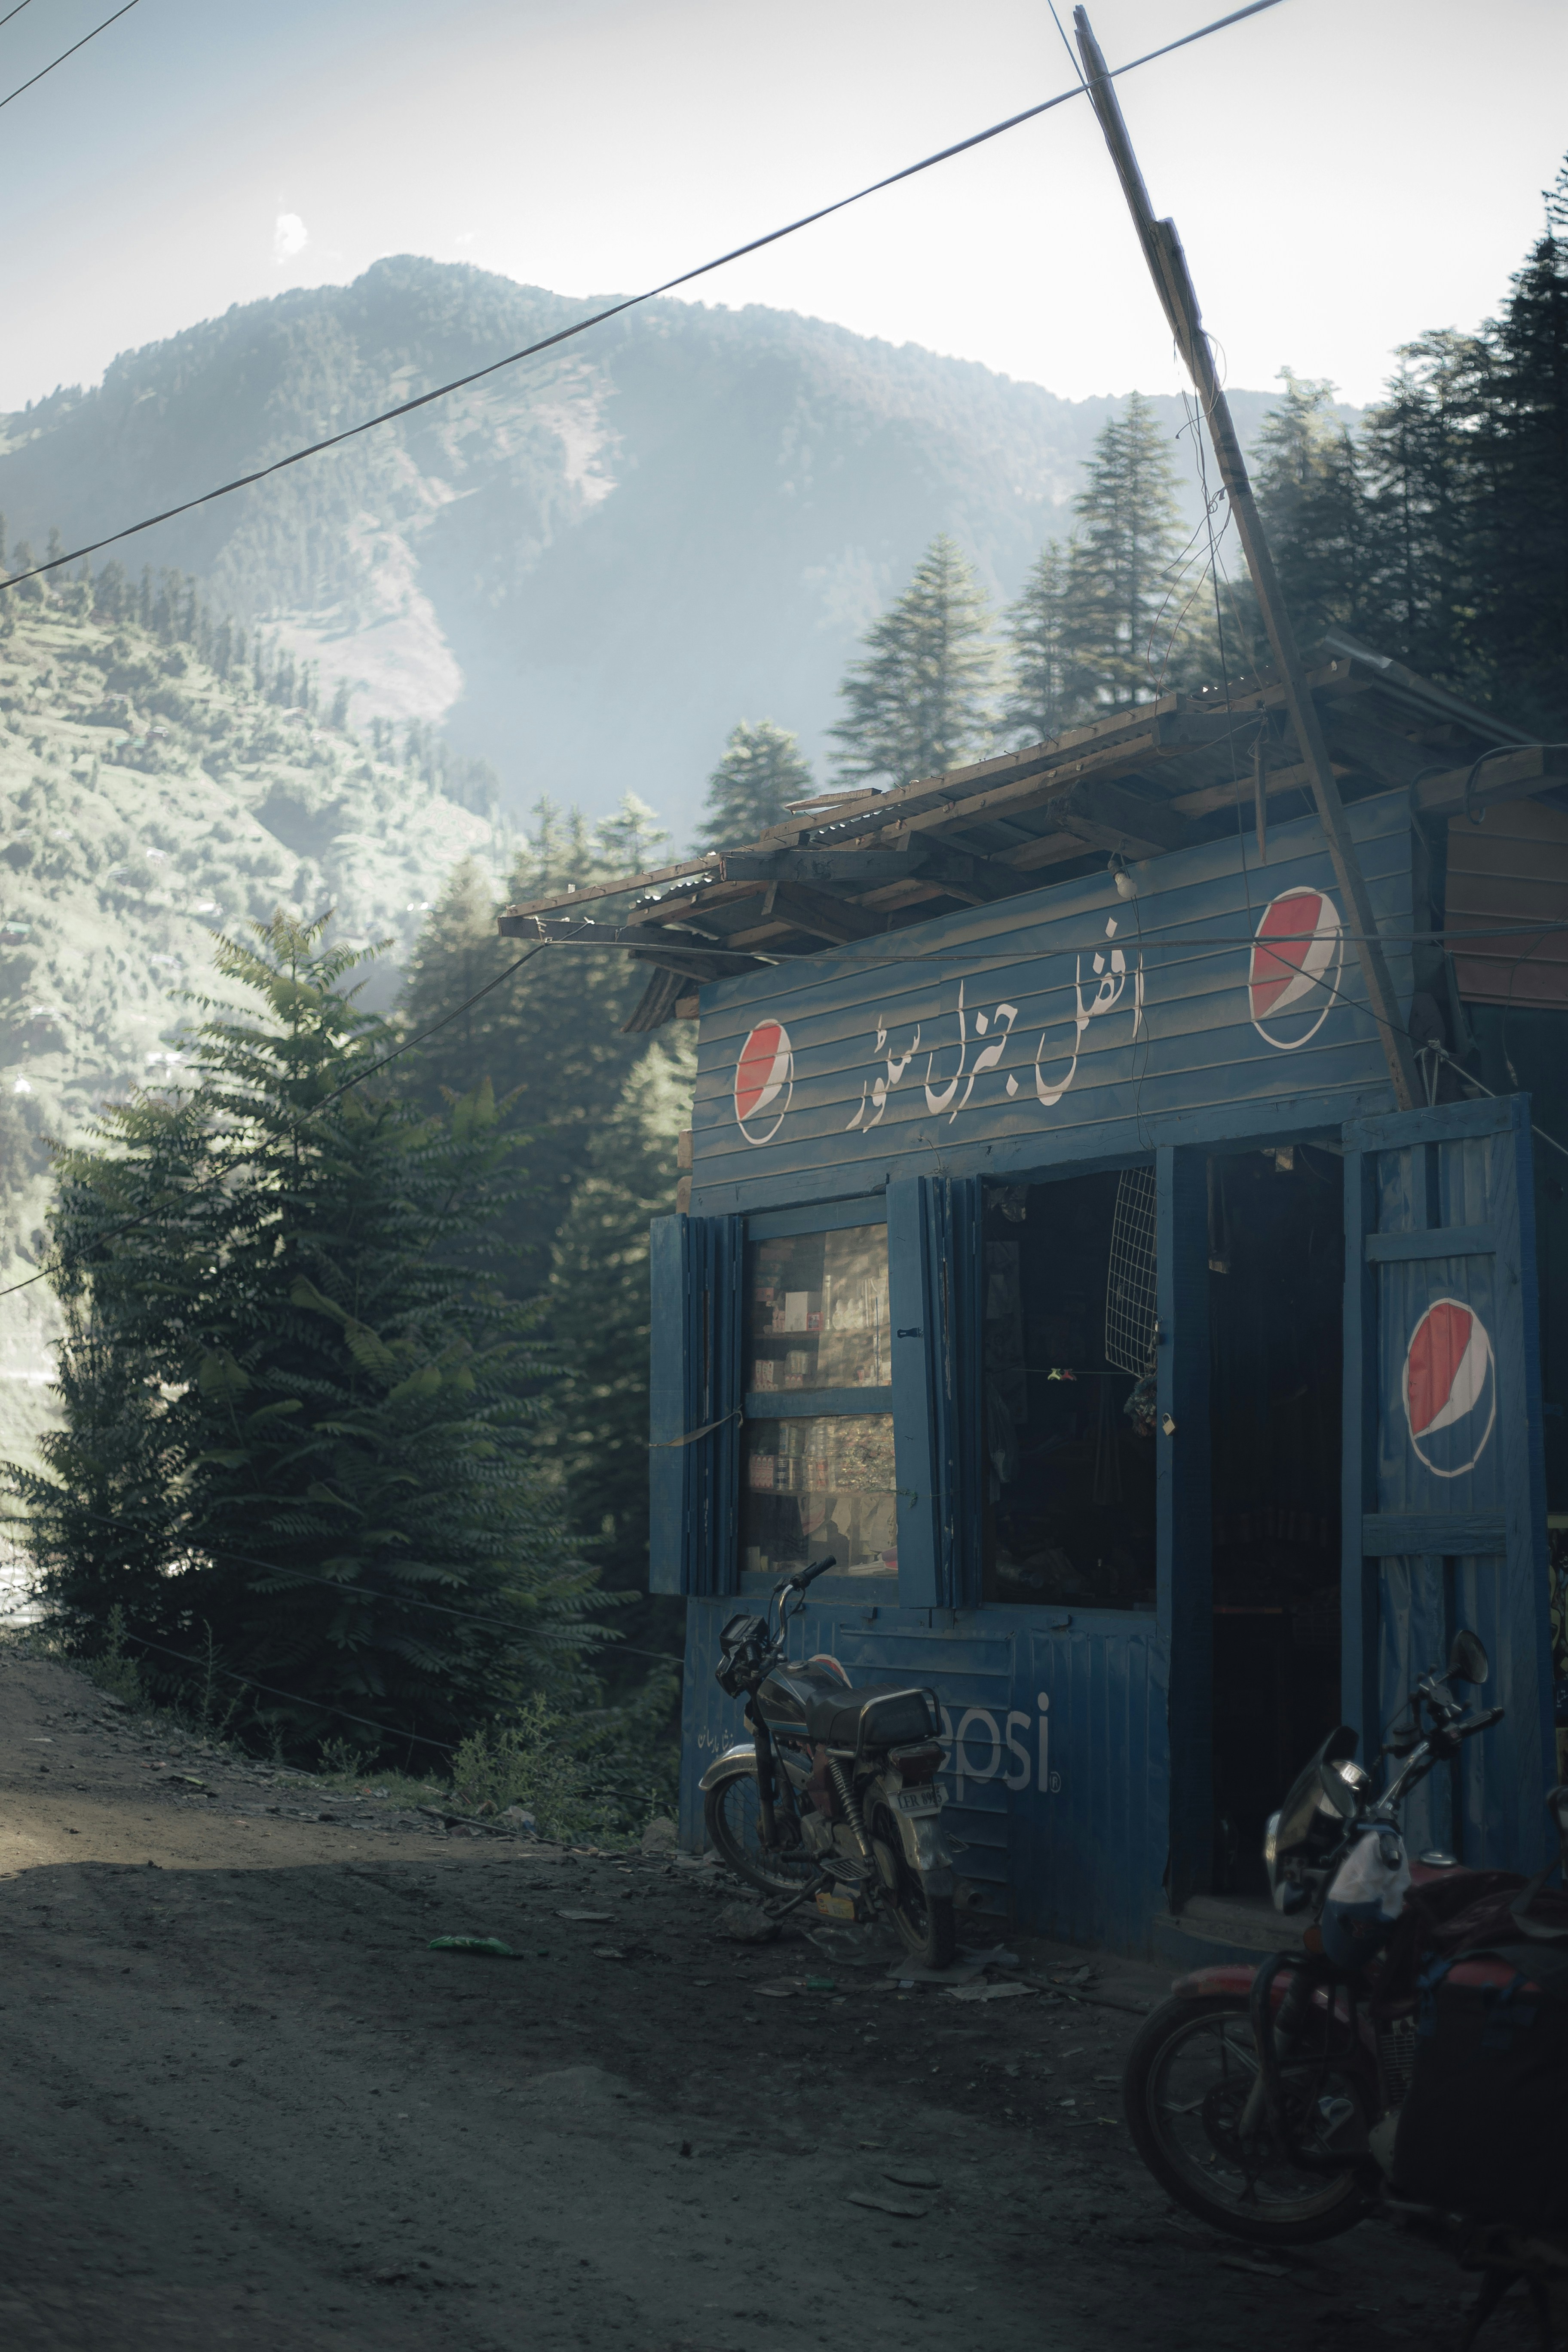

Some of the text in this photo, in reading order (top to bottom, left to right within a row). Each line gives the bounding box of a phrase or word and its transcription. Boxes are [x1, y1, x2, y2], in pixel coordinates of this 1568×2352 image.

[845, 1014, 920, 1133] سٹور
[923, 979, 1018, 1124] جنرل
[897, 1794, 920, 1809] LER
[926, 1692, 1049, 1801] epsi
